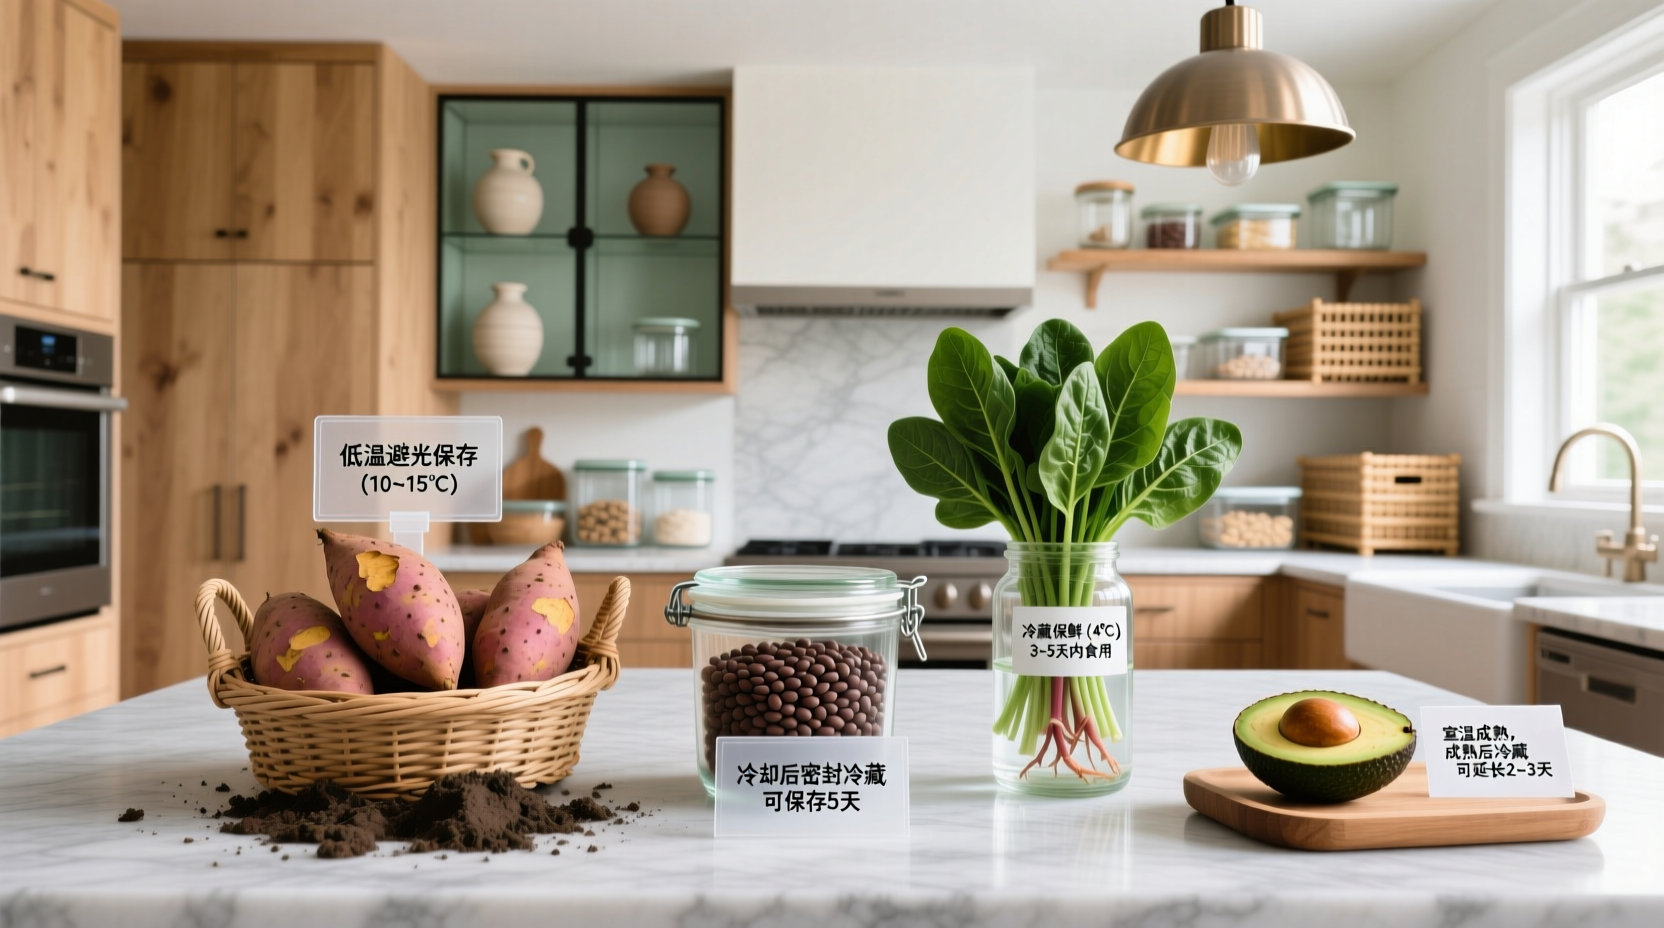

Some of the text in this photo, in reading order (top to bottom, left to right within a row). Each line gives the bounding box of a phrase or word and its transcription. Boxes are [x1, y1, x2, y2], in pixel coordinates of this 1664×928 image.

[339, 442, 479, 468] 低温避光保存
[736, 761, 887, 787] 冷却后密封冷藏
[762, 789, 861, 813] 可保存5天
